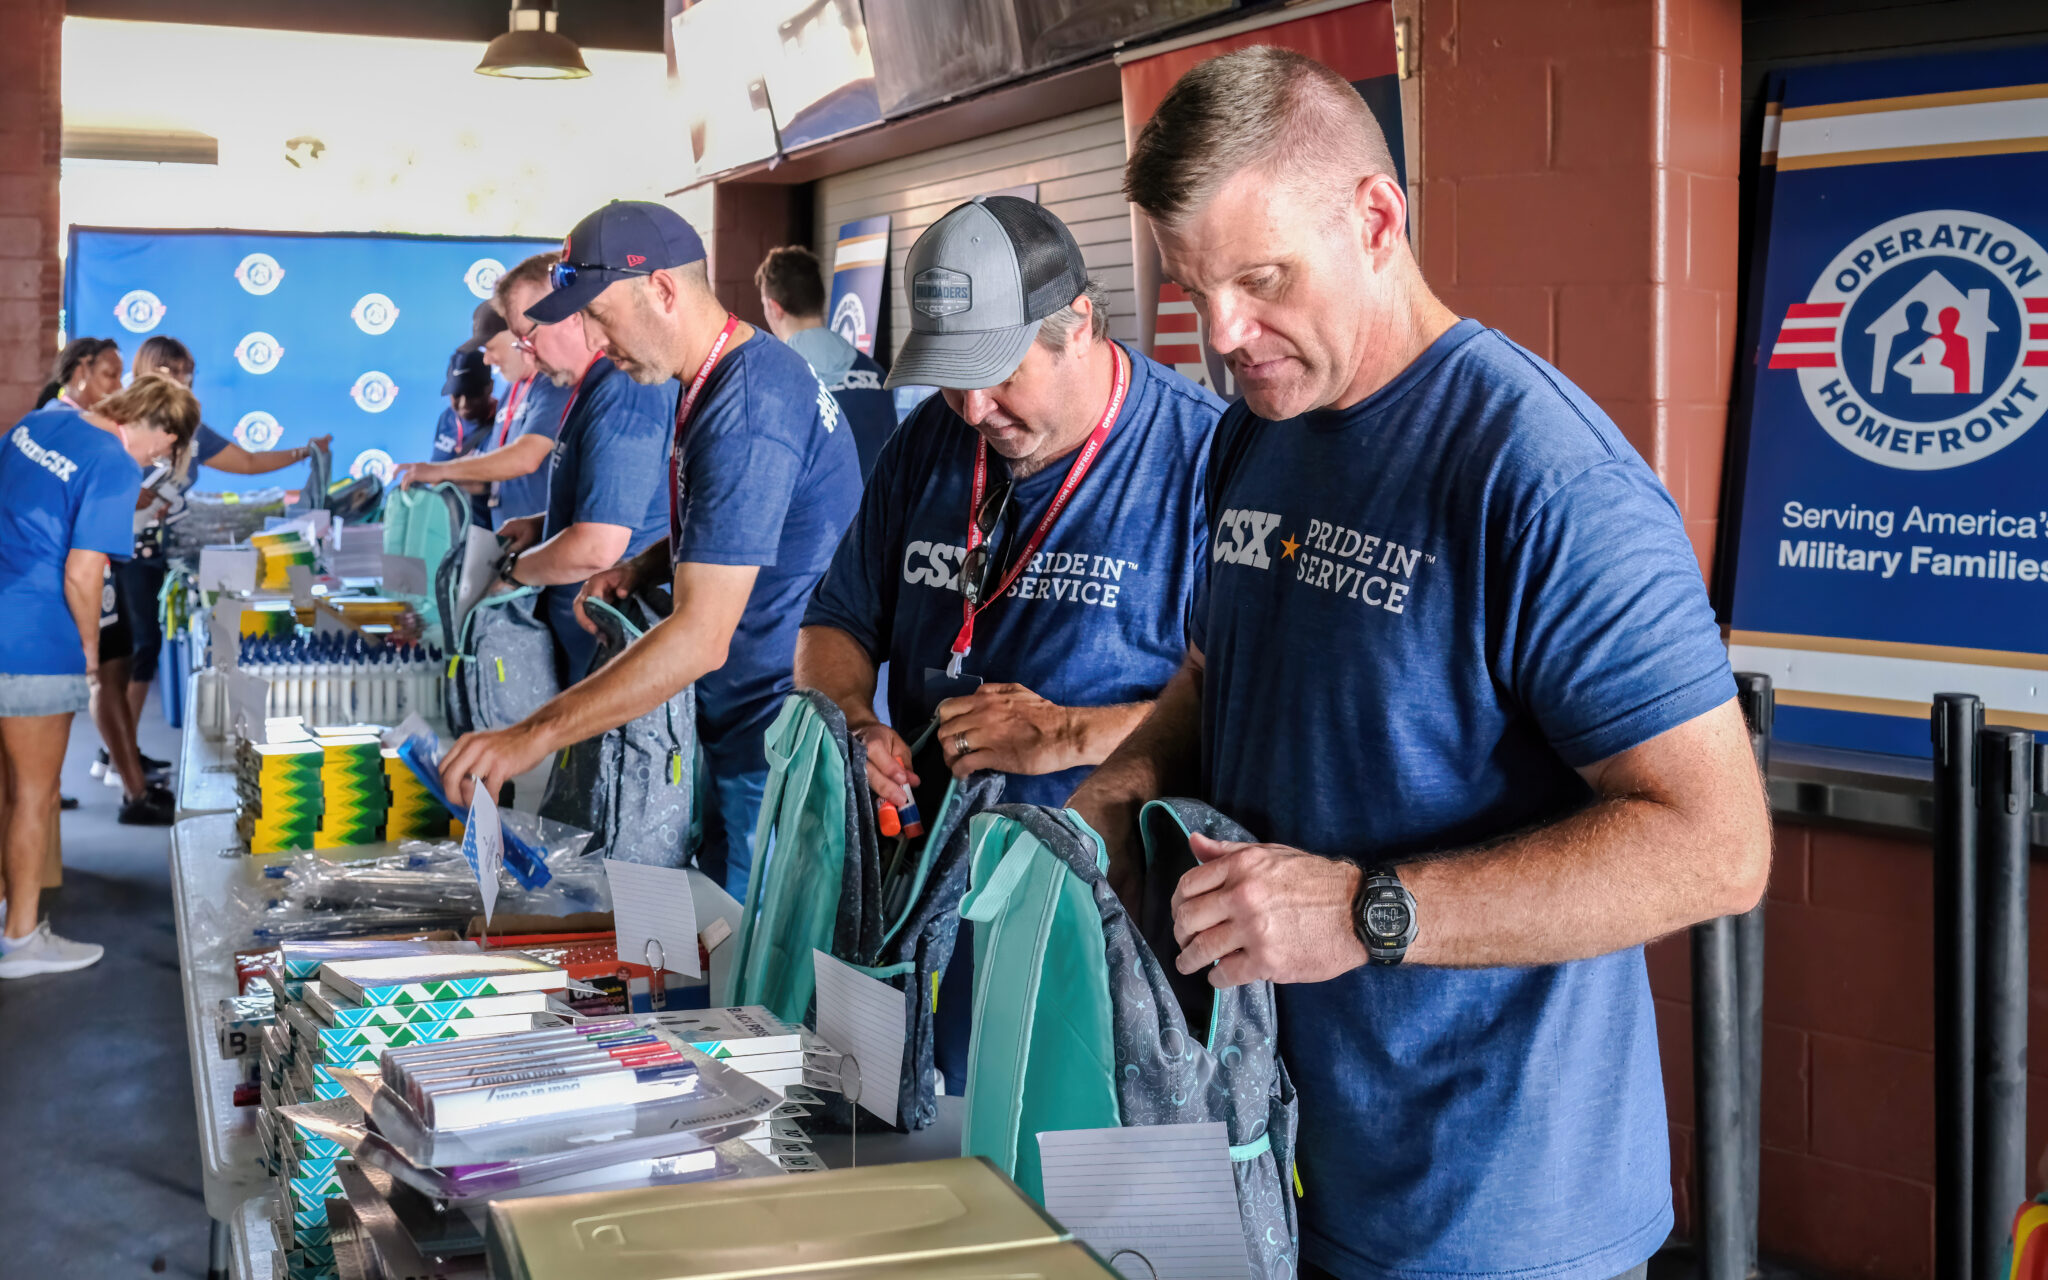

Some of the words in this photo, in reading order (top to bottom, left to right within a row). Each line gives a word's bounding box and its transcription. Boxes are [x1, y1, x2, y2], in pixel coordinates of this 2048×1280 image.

[1834, 223, 2042, 294] OPERATION
[1101, 383, 1124, 429] OPERATION
[1818, 376, 2039, 455] HOMEFRONT
[1039, 486, 1070, 533] OPERATION
[1067, 439, 1099, 490] HOMEFRONT
[1212, 508, 1283, 571] CSX
[1782, 501, 1894, 538] Serving
[1902, 506, 2048, 539] America'
[1025, 551, 1089, 577] RIDE
[1089, 556, 1126, 582] IN
[1304, 518, 1381, 566] PRIDE
[1378, 542, 1422, 579] IN
[1778, 539, 1902, 579] Military
[1296, 552, 1410, 614] SERVICE
[780, 1105, 802, 1114] 10
[782, 1129, 803, 1138] 10
[782, 1143, 804, 1152] 10
[787, 1157, 809, 1166] 10
